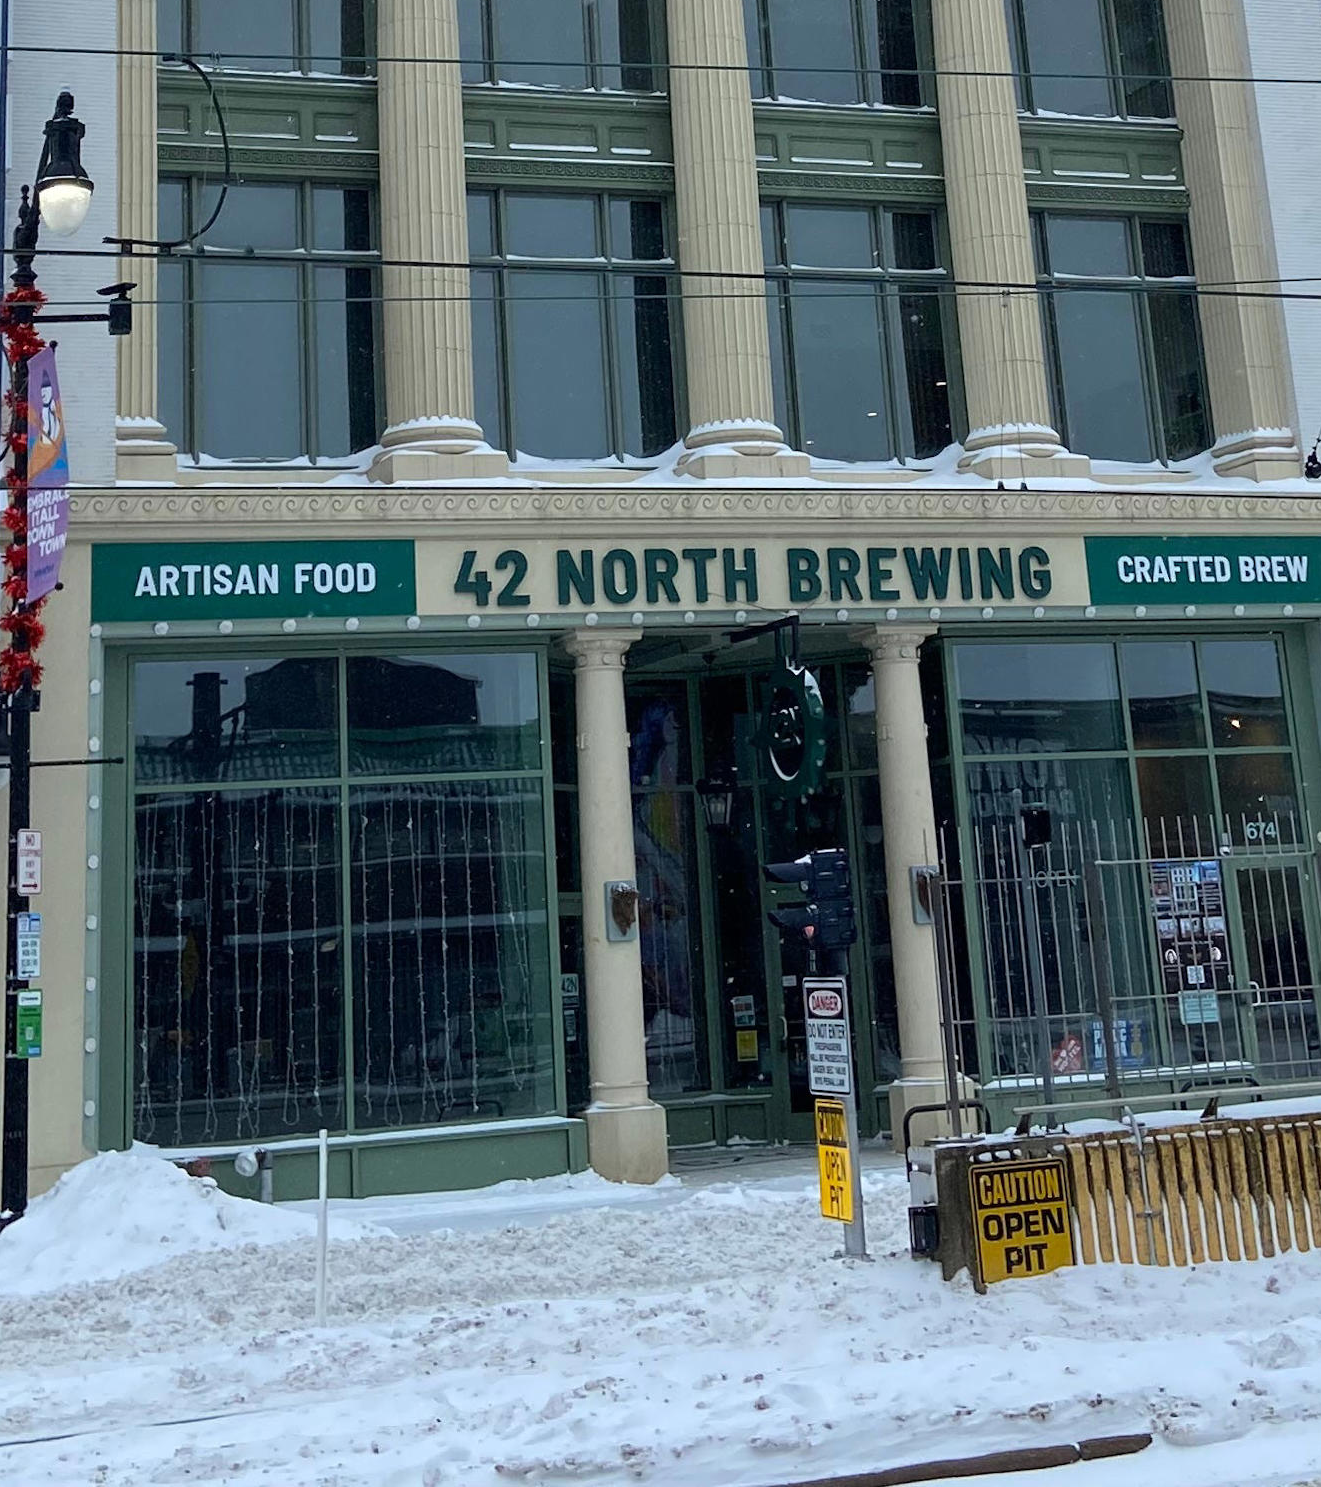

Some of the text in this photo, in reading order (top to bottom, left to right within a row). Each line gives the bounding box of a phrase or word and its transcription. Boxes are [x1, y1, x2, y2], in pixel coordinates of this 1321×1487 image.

[39, 532, 67, 557] TOWN
[134, 562, 377, 596] ARTISAN FOOD
[453, 546, 1053, 606] 42 NORTH BREWING
[1117, 555, 1309, 583] CRAFTED BREW
[1246, 821, 1278, 840] 674
[979, 1168, 1060, 1205] CAUTION
[982, 1207, 1065, 1241] OPEN
[1004, 1243, 1048, 1273] PIT
